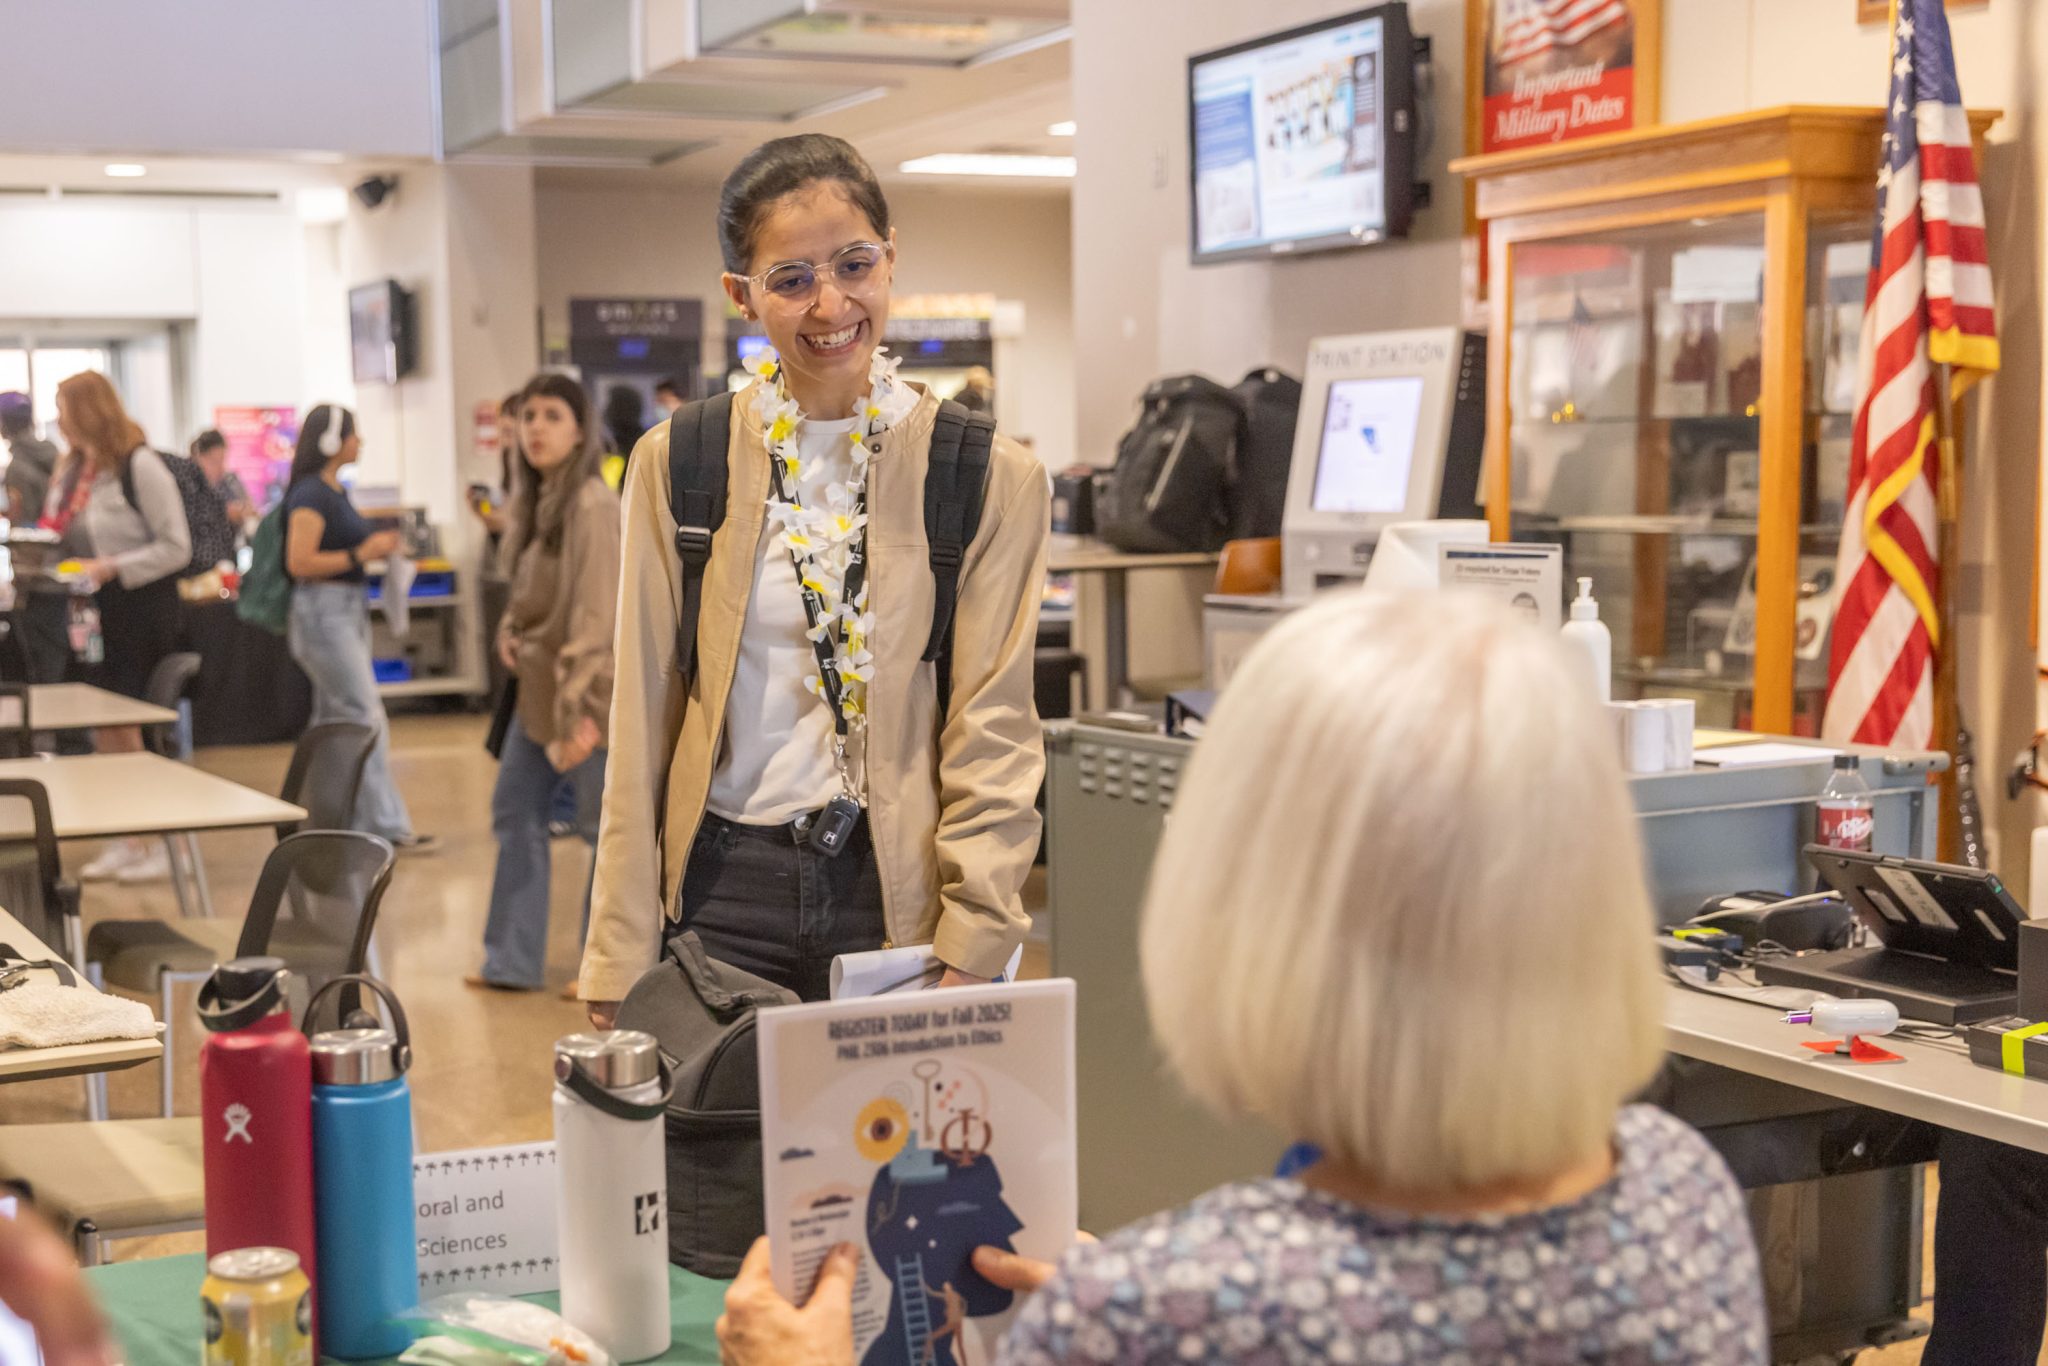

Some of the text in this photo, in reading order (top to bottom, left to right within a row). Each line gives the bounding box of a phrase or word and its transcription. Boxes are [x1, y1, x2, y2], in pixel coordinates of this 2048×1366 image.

[1512, 60, 1604, 110] Important
[1492, 94, 1625, 143] Military Dates
[1312, 341, 1446, 368] PRINT STATION
[828, 1017, 887, 1040] REGISTER
[891, 1012, 928, 1032] TODAY
[932, 1011, 949, 1028] for
[952, 1006, 974, 1024] Fall
[892, 1034, 955, 1054] Introduction
[957, 1032, 968, 1046] to
[970, 1029, 1003, 1045] Ethics
[465, 1189, 504, 1213] and
[417, 1233, 508, 1257] Sciences
